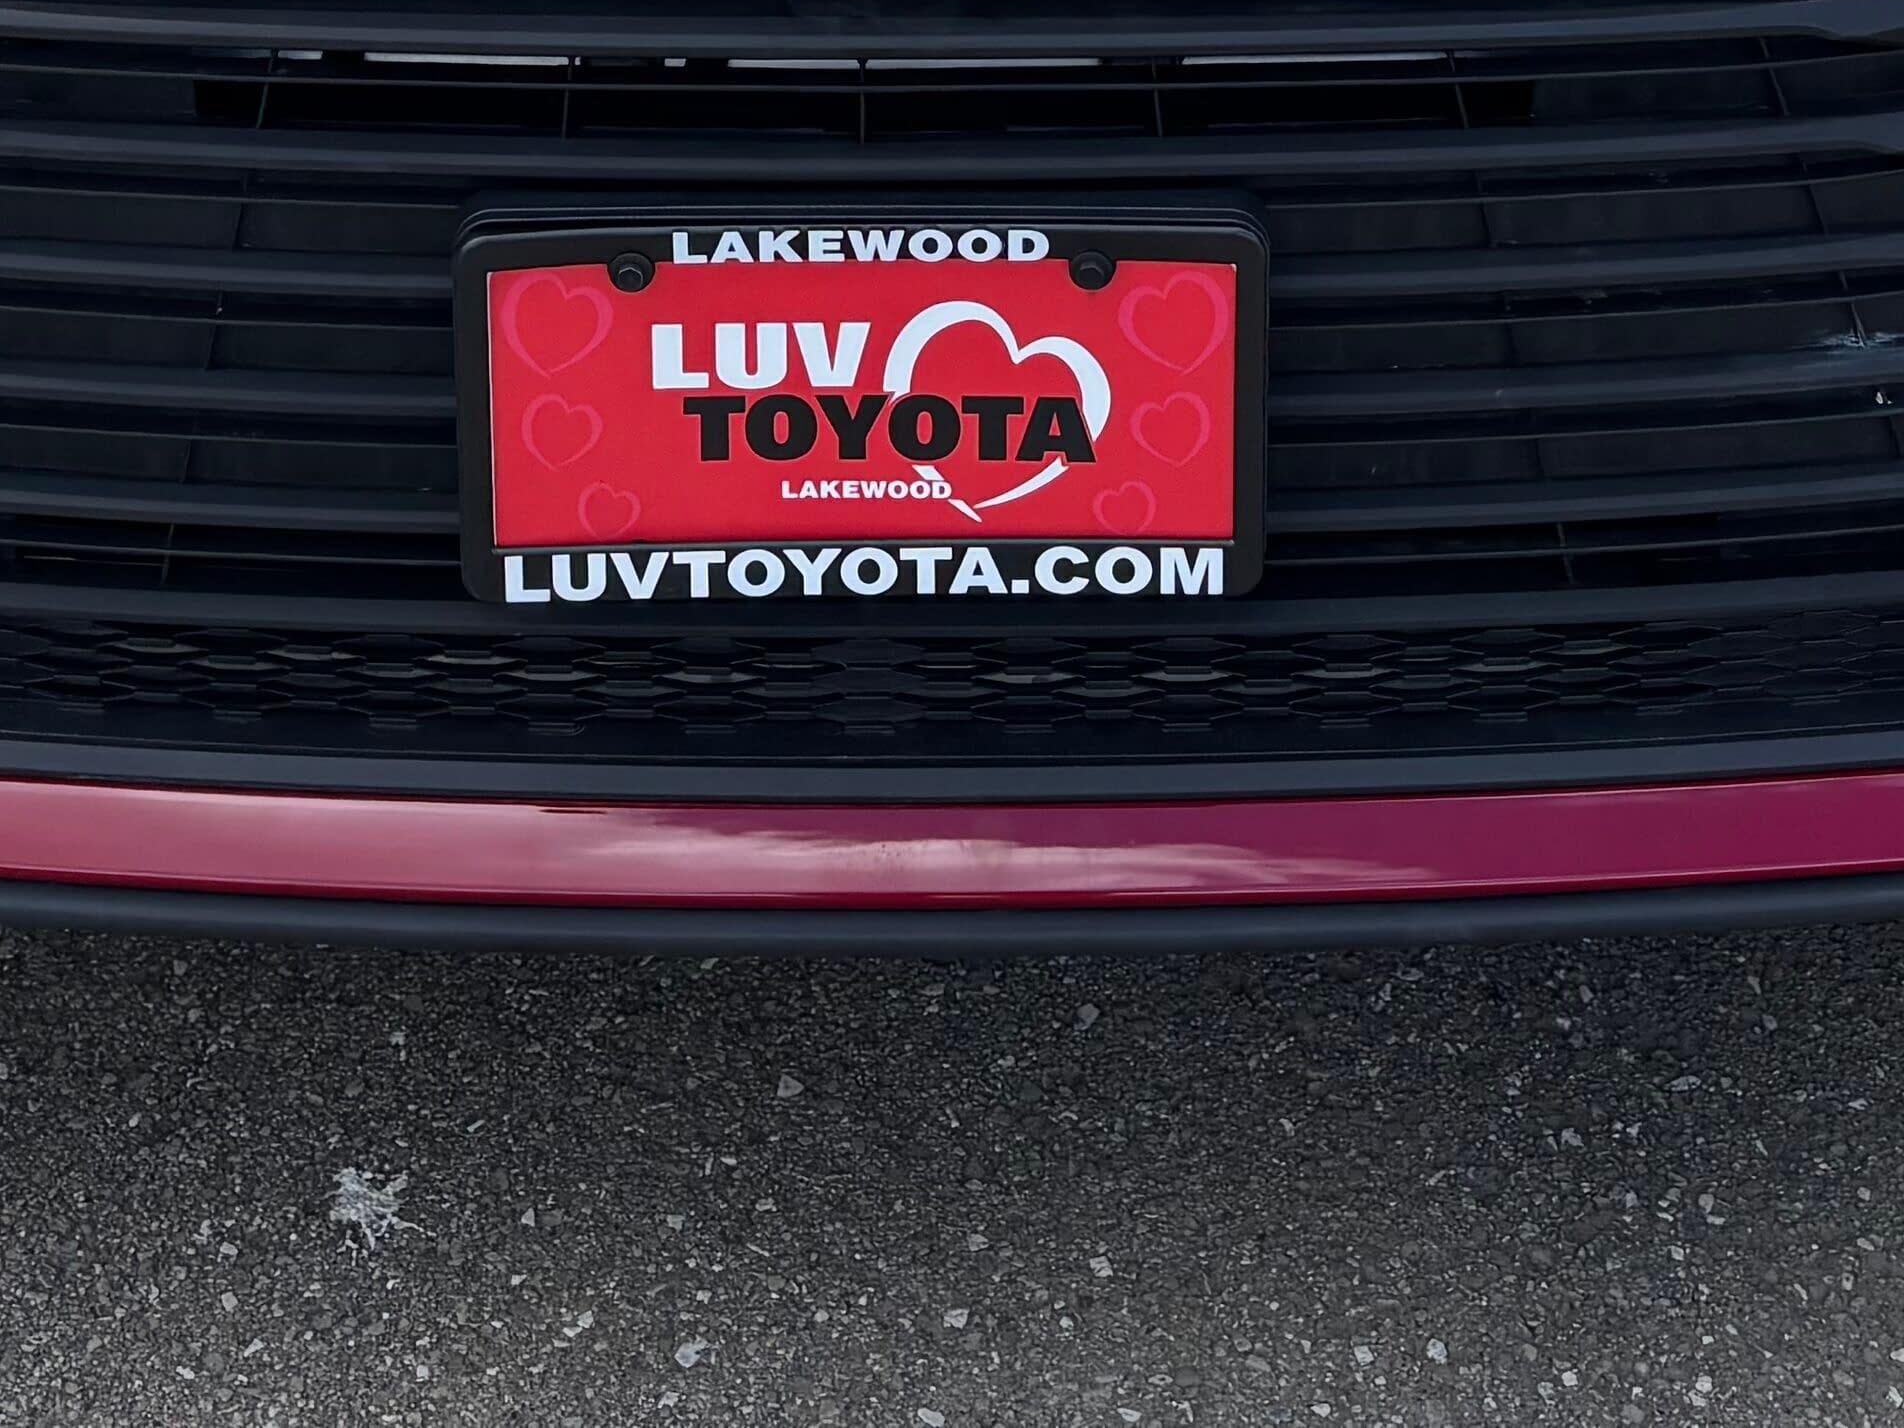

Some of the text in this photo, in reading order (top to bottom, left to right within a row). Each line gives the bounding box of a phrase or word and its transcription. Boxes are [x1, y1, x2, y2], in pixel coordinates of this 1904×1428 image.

[672, 229, 1050, 264] LAKEWOOD
[651, 321, 872, 390] LUV
[682, 393, 1097, 463] TOYOTA
[781, 479, 953, 500] LAKEWOOD
[503, 545, 1225, 603] LUVTOYOTA.COM
